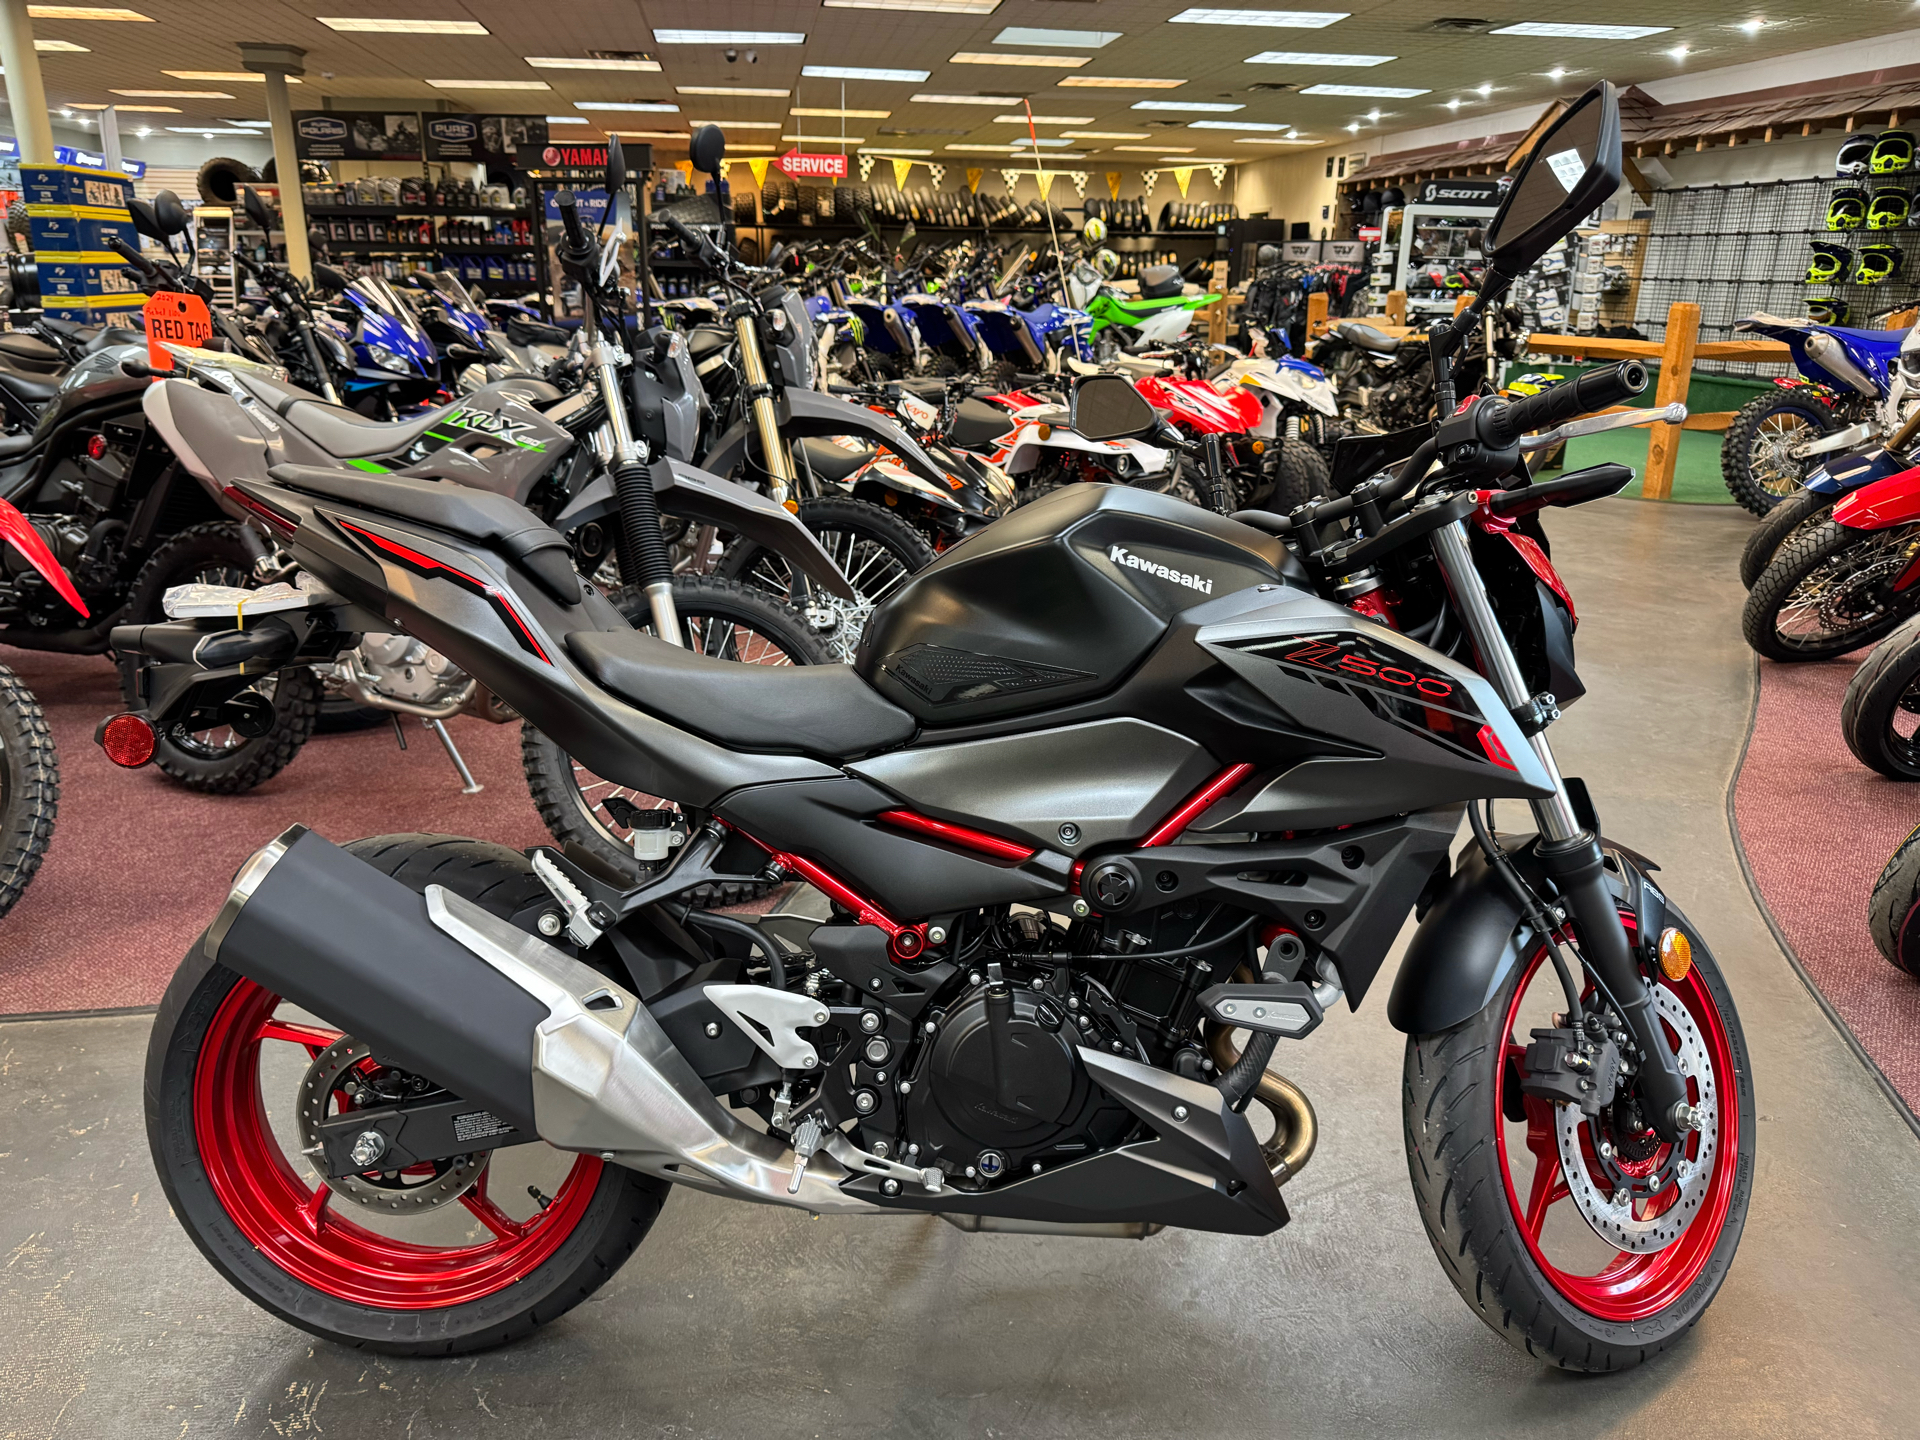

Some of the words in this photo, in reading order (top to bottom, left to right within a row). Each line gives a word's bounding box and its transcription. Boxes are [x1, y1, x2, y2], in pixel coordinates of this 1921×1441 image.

[782, 157, 844, 174] SERVICE
[1436, 188, 1493, 200] SCOTT
[151, 318, 184, 340] RED
[187, 321, 209, 342] TAG
[448, 406, 537, 446] KLX
[1110, 545, 1213, 595] Kawasaki
[894, 664, 932, 696] Kawasaki
